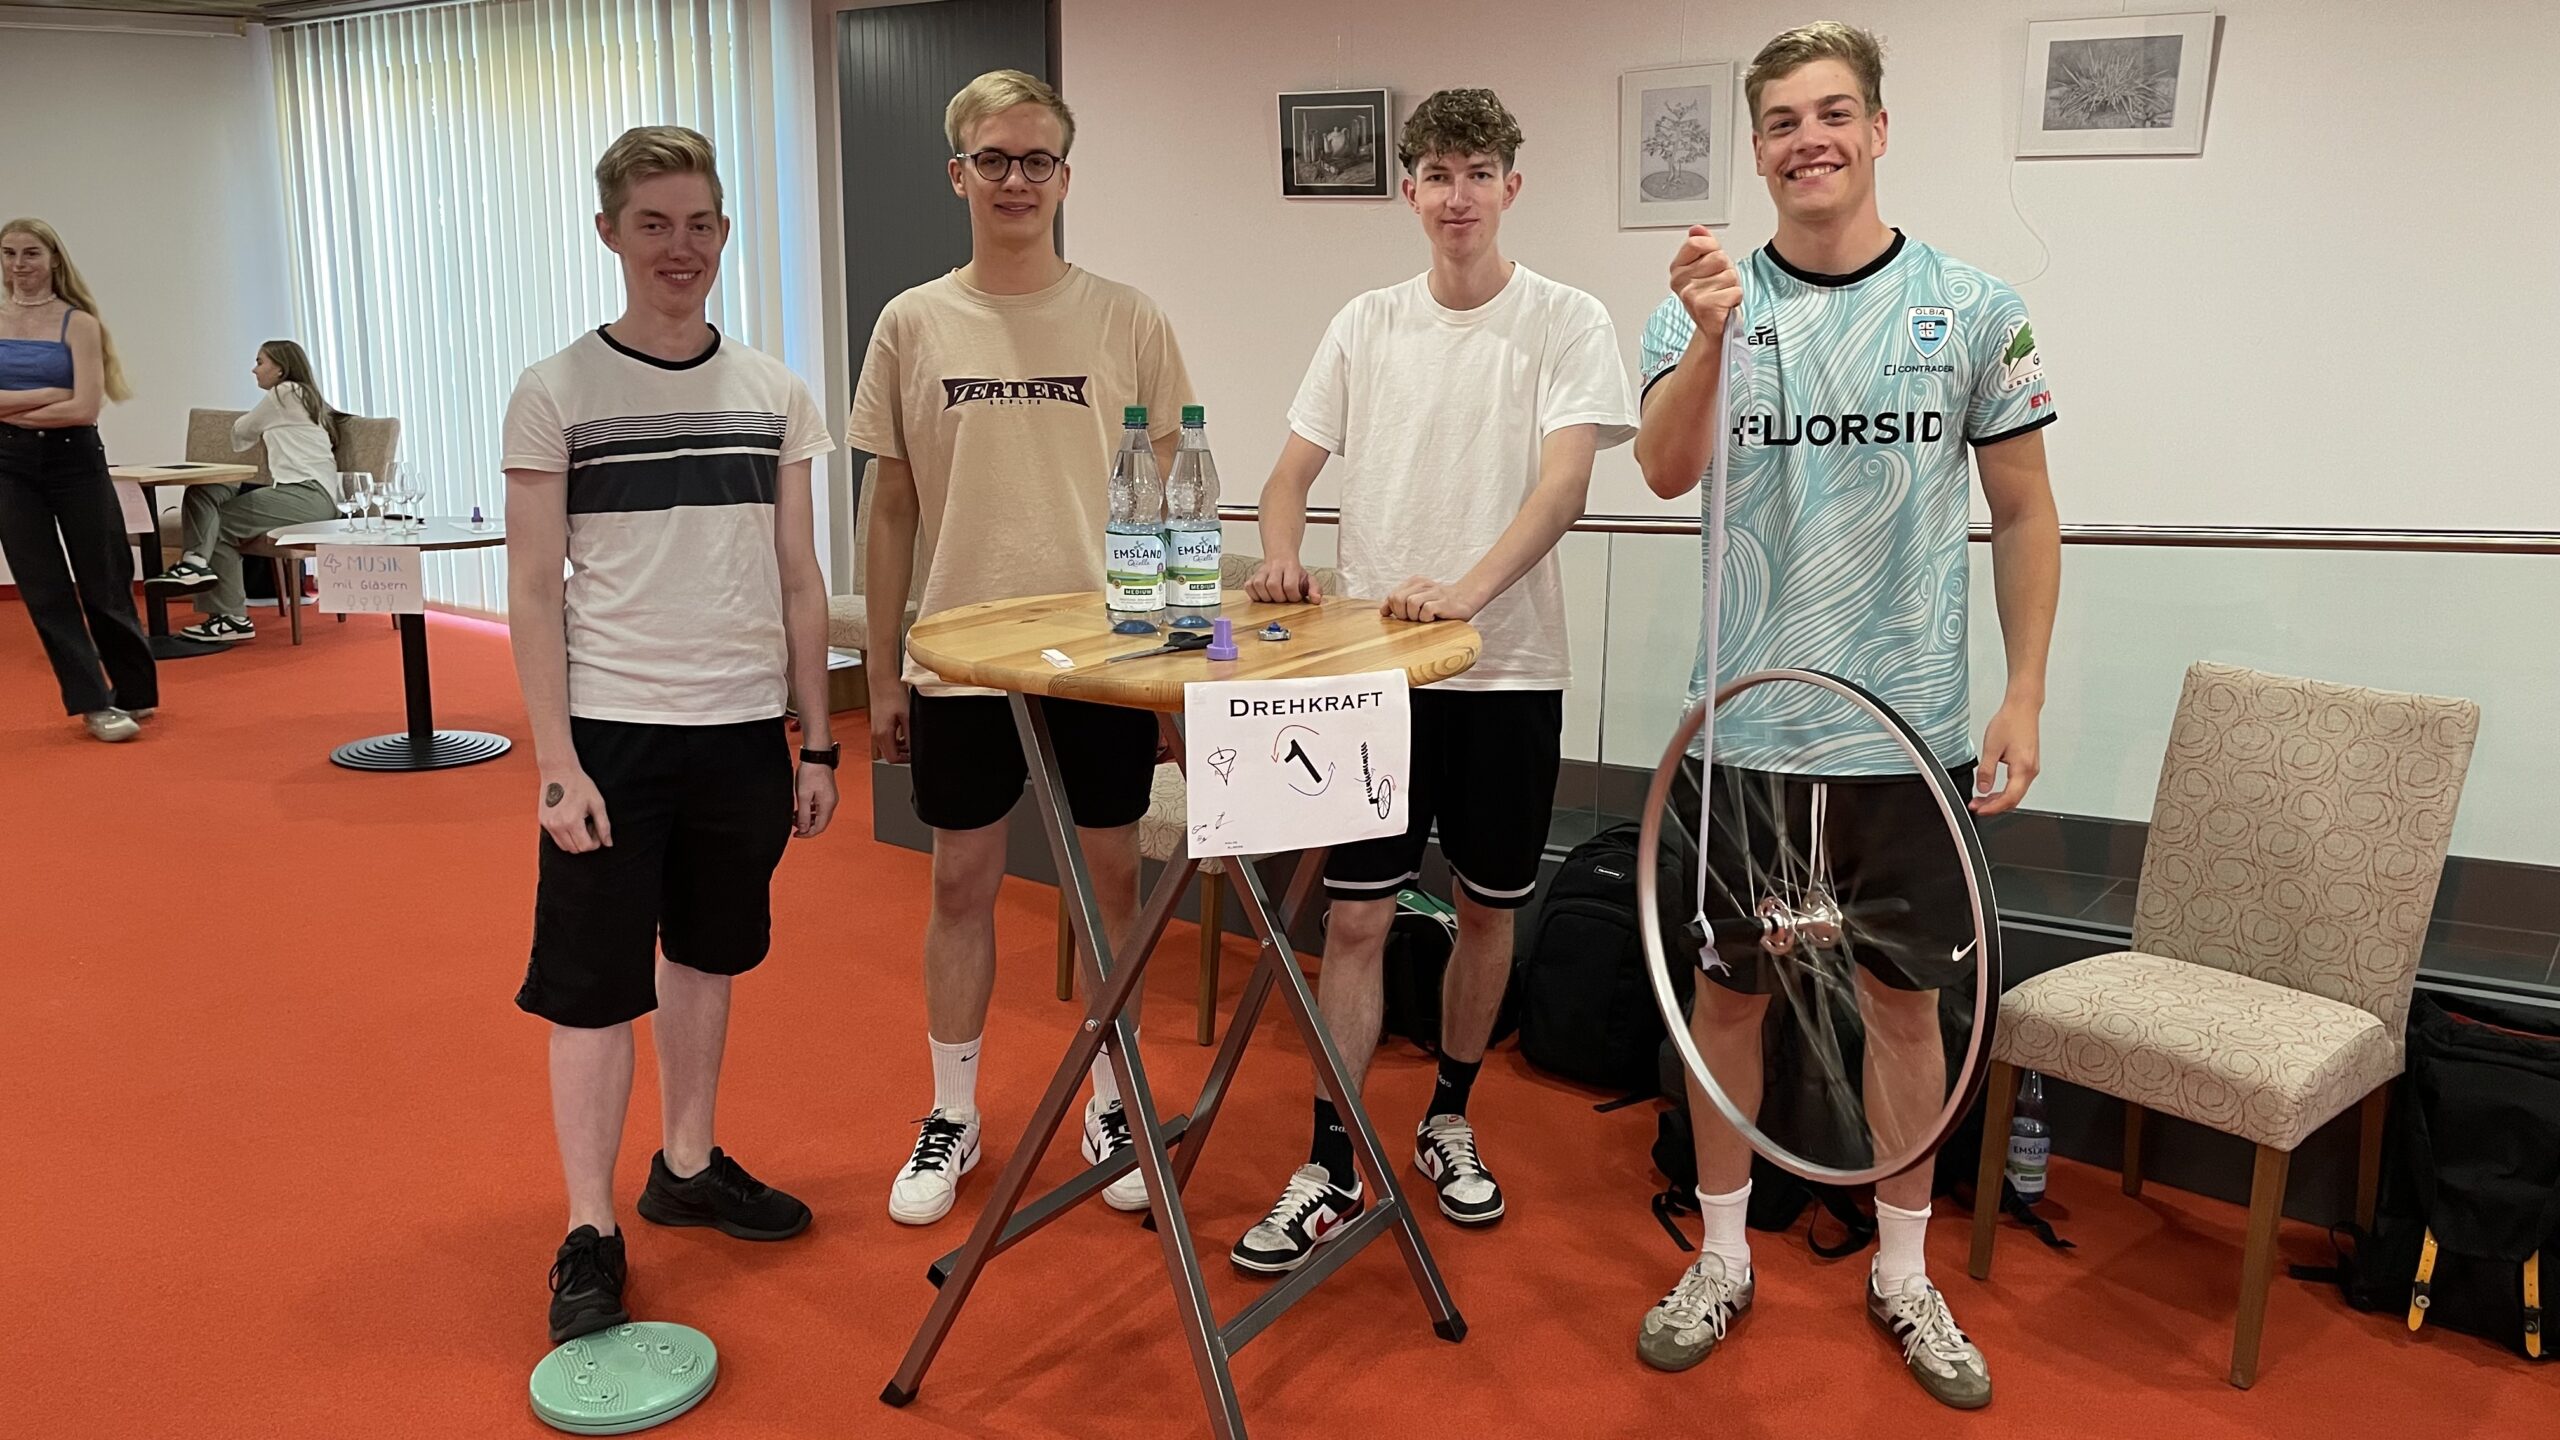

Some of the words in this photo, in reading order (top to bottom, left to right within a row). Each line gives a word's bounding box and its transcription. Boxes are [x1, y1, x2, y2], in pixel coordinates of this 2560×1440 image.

[1915, 308, 1946, 316] OLBIA
[1897, 365, 1955, 373] CONTRADER
[2008, 373, 2043, 389] GREE
[2030, 390, 2052, 409] EY
[1732, 411, 1943, 447] FLUORSID
[1113, 548, 1162, 560] EMSLAND
[323, 553, 342, 574] 4
[346, 556, 403, 574] MUSIK
[332, 579, 353, 591] mit
[2013, 1145, 2049, 1155] EMSLA
